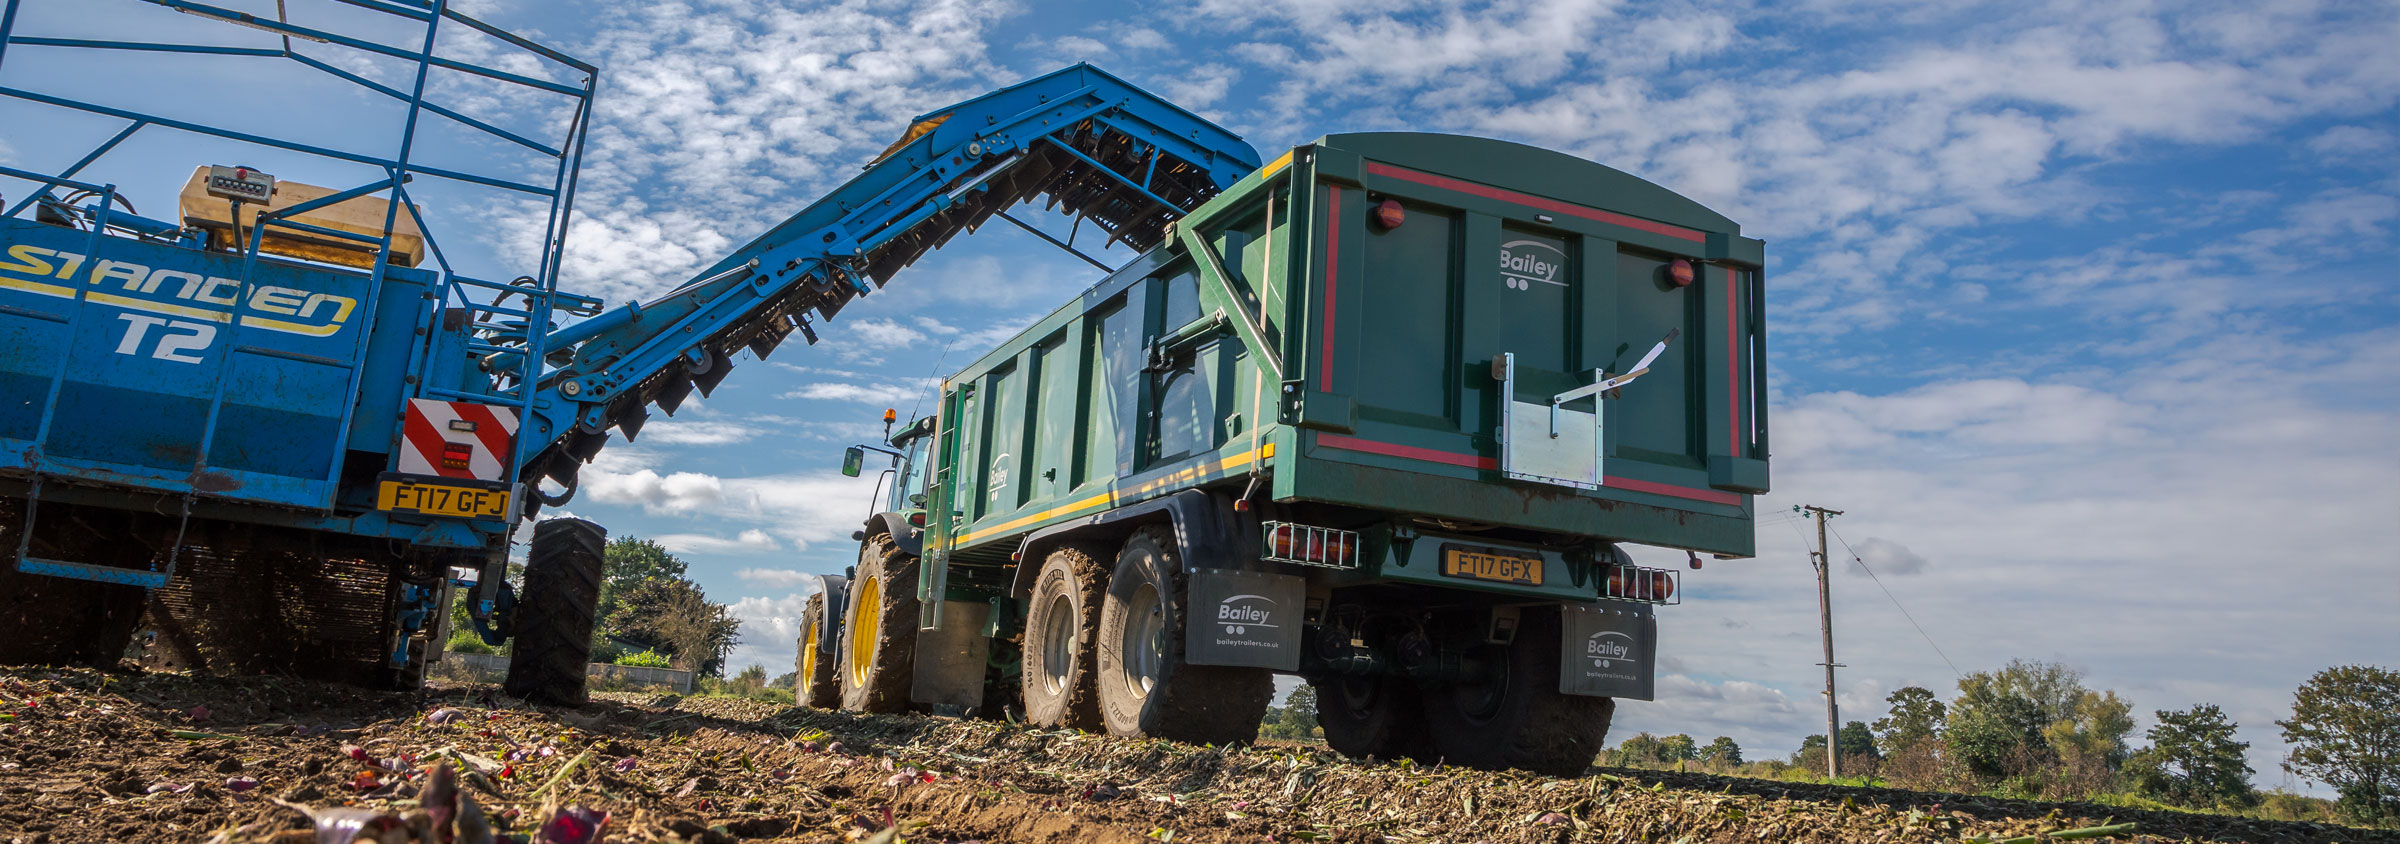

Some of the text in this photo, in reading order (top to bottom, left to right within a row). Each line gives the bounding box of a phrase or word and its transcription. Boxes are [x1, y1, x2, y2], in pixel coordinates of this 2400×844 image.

[1500, 249, 1558, 281] Bailey
[0, 245, 357, 323] STANDEN
[115, 312, 217, 364] T2
[990, 466, 1008, 486] Bailey
[394, 485, 506, 514] FT17 GFJ
[1458, 553, 1531, 579] FT17 GFX
[1218, 604, 1270, 625] Bailey
[1216, 638, 1279, 648] baileytrailers.co.uk
[1587, 639, 1628, 660] Bailey
